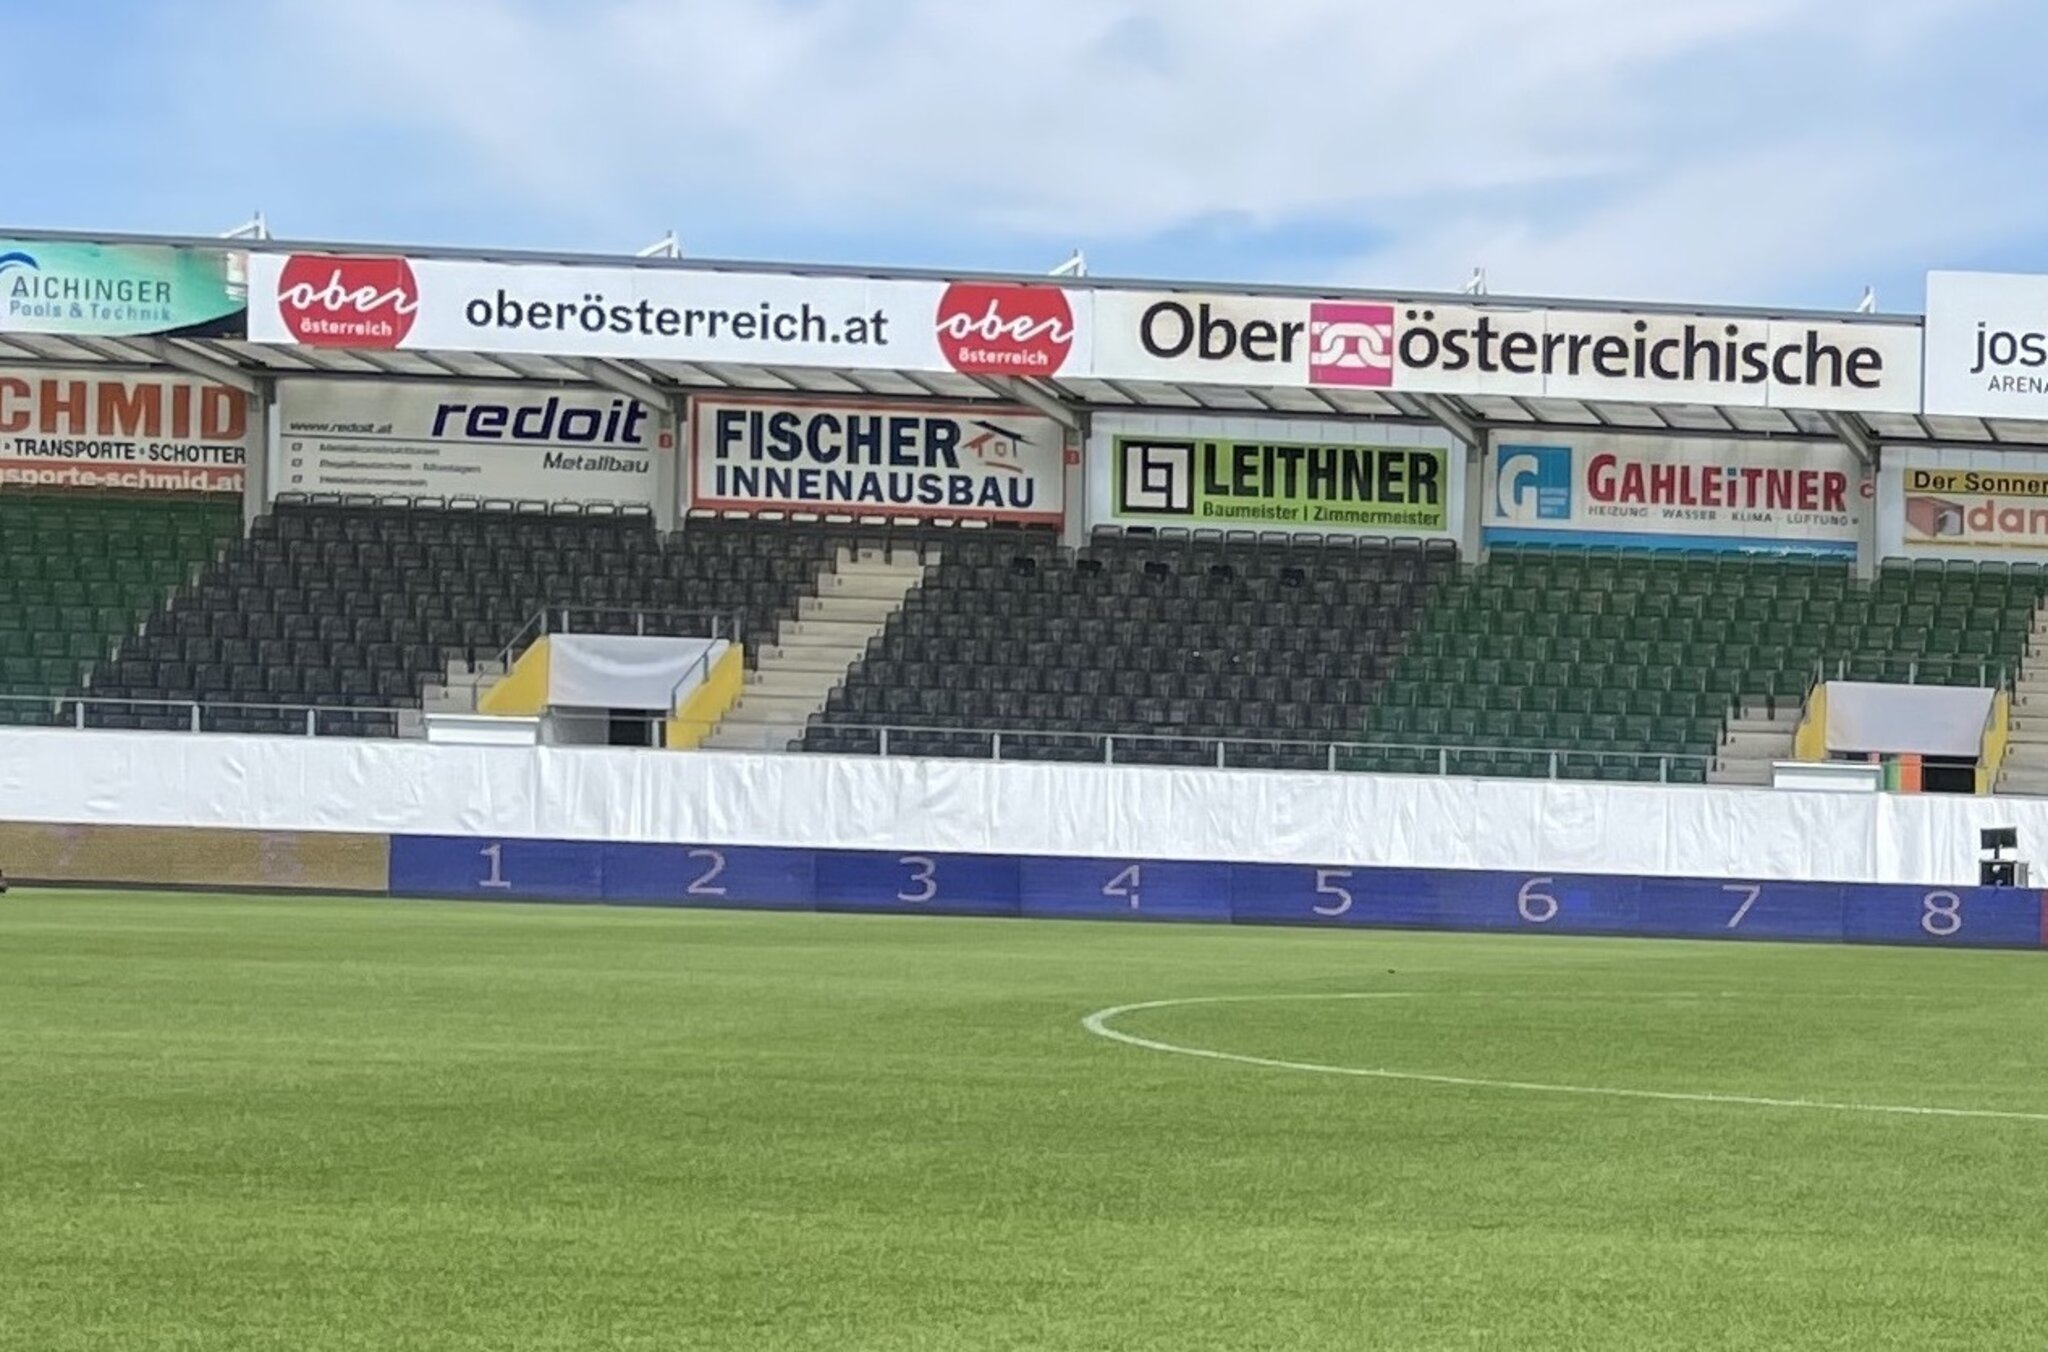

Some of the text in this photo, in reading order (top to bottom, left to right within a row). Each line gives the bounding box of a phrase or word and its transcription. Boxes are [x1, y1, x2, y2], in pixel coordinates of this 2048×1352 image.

[9, 300, 62, 319] Pools
[91, 302, 171, 321] Technik
[10, 275, 171, 303] AICHINGER
[278, 268, 419, 315] ober
[301, 316, 393, 337] österreich
[466, 289, 888, 346] oberösterreich.at
[936, 298, 1074, 344] ober
[959, 346, 1048, 367] österreich
[1140, 301, 1882, 388] Ober österreichische
[0, 377, 246, 441] CHMID
[432, 397, 648, 444] redoit
[15, 438, 247, 464] TRANSPORTE SCHOTTER
[716, 409, 961, 469] FISCHER
[543, 451, 650, 474] Metallbau
[1203, 442, 1439, 505] LEITHNER
[1914, 471, 1957, 489] Der
[715, 464, 1035, 508] INNENAUSBAU
[1203, 502, 1299, 522] Baumeister
[1313, 506, 1441, 527] Zimmermeister
[1588, 506, 1648, 518] HEIZUNG
[1662, 508, 1717, 521] WASSER
[1732, 512, 1773, 523] KLIMA
[478, 843, 1962, 936] 1 2 3 4 5 6 7 8
